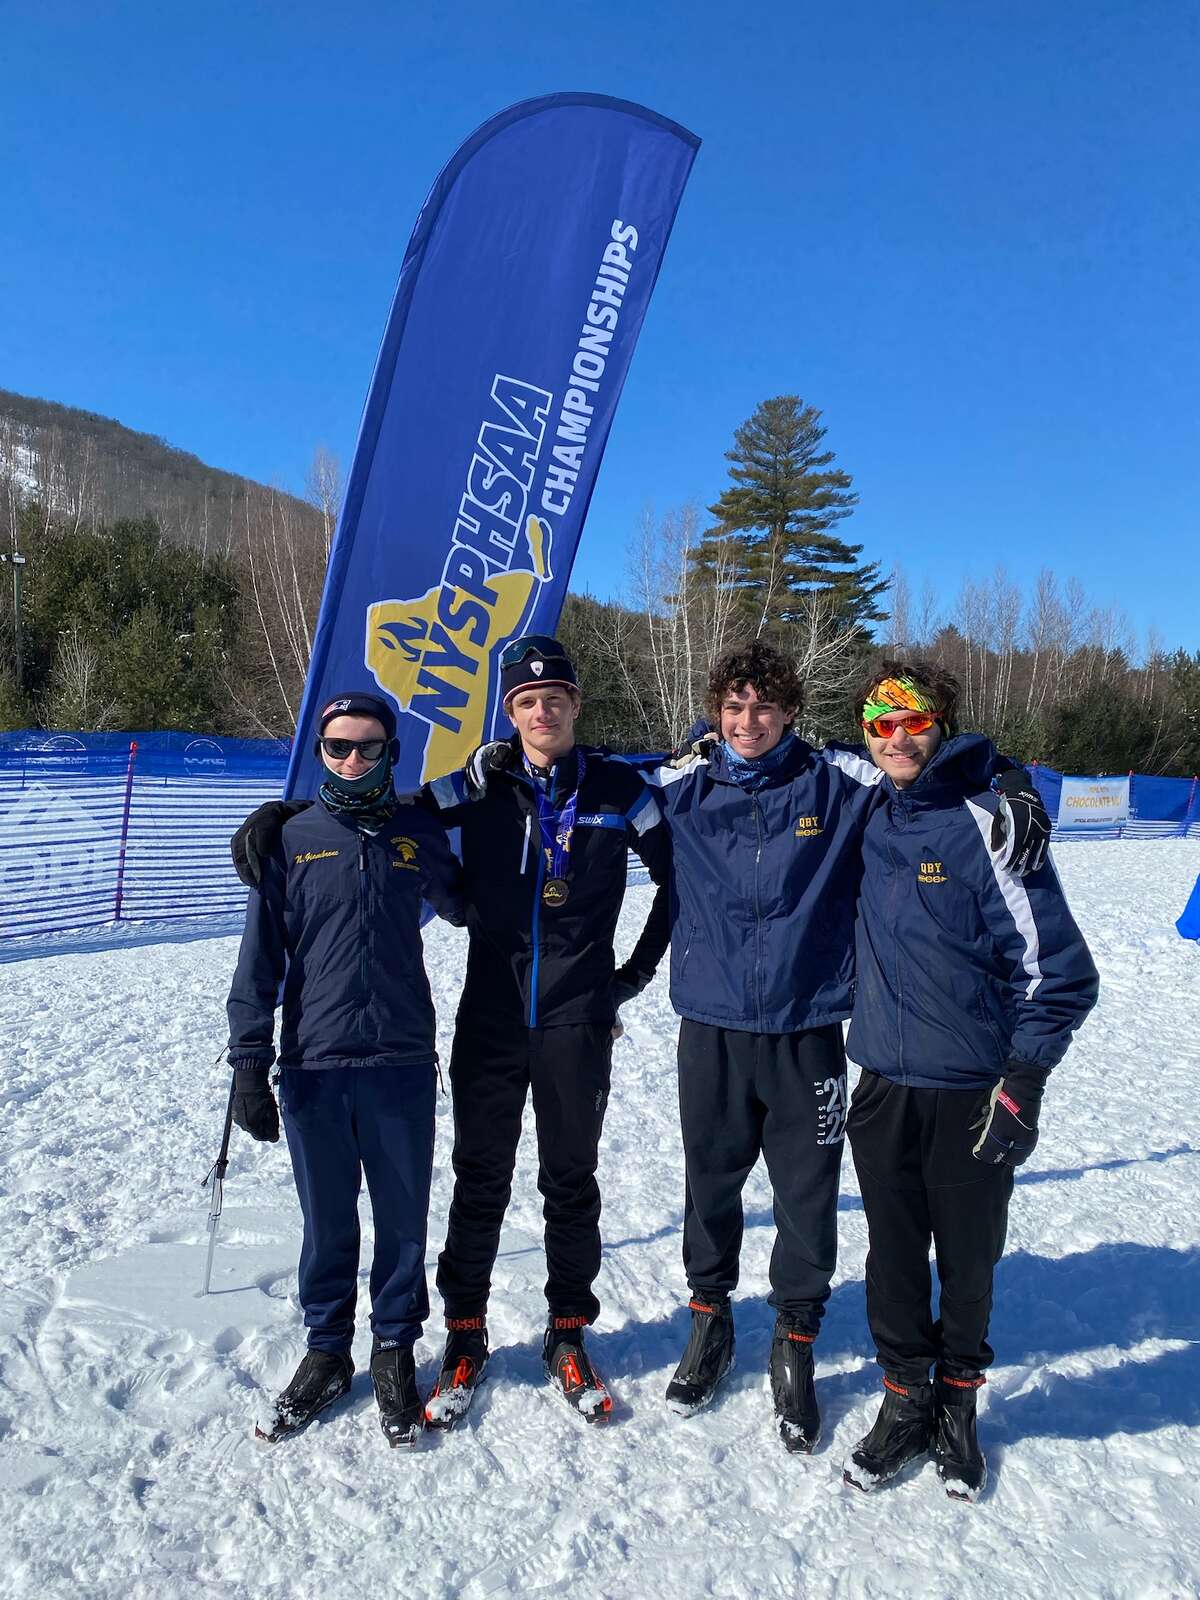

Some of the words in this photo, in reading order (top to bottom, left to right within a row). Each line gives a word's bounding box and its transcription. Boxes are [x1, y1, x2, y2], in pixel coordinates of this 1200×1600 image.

[541, 218, 640, 516] CHAMPIONSHIPS
[408, 373, 553, 734] NYSPHSAA
[799, 816, 818, 828] QBY
[920, 862, 942, 874] QBY
[813, 1081, 824, 1096] OF
[816, 1105, 827, 1145] CLASS
